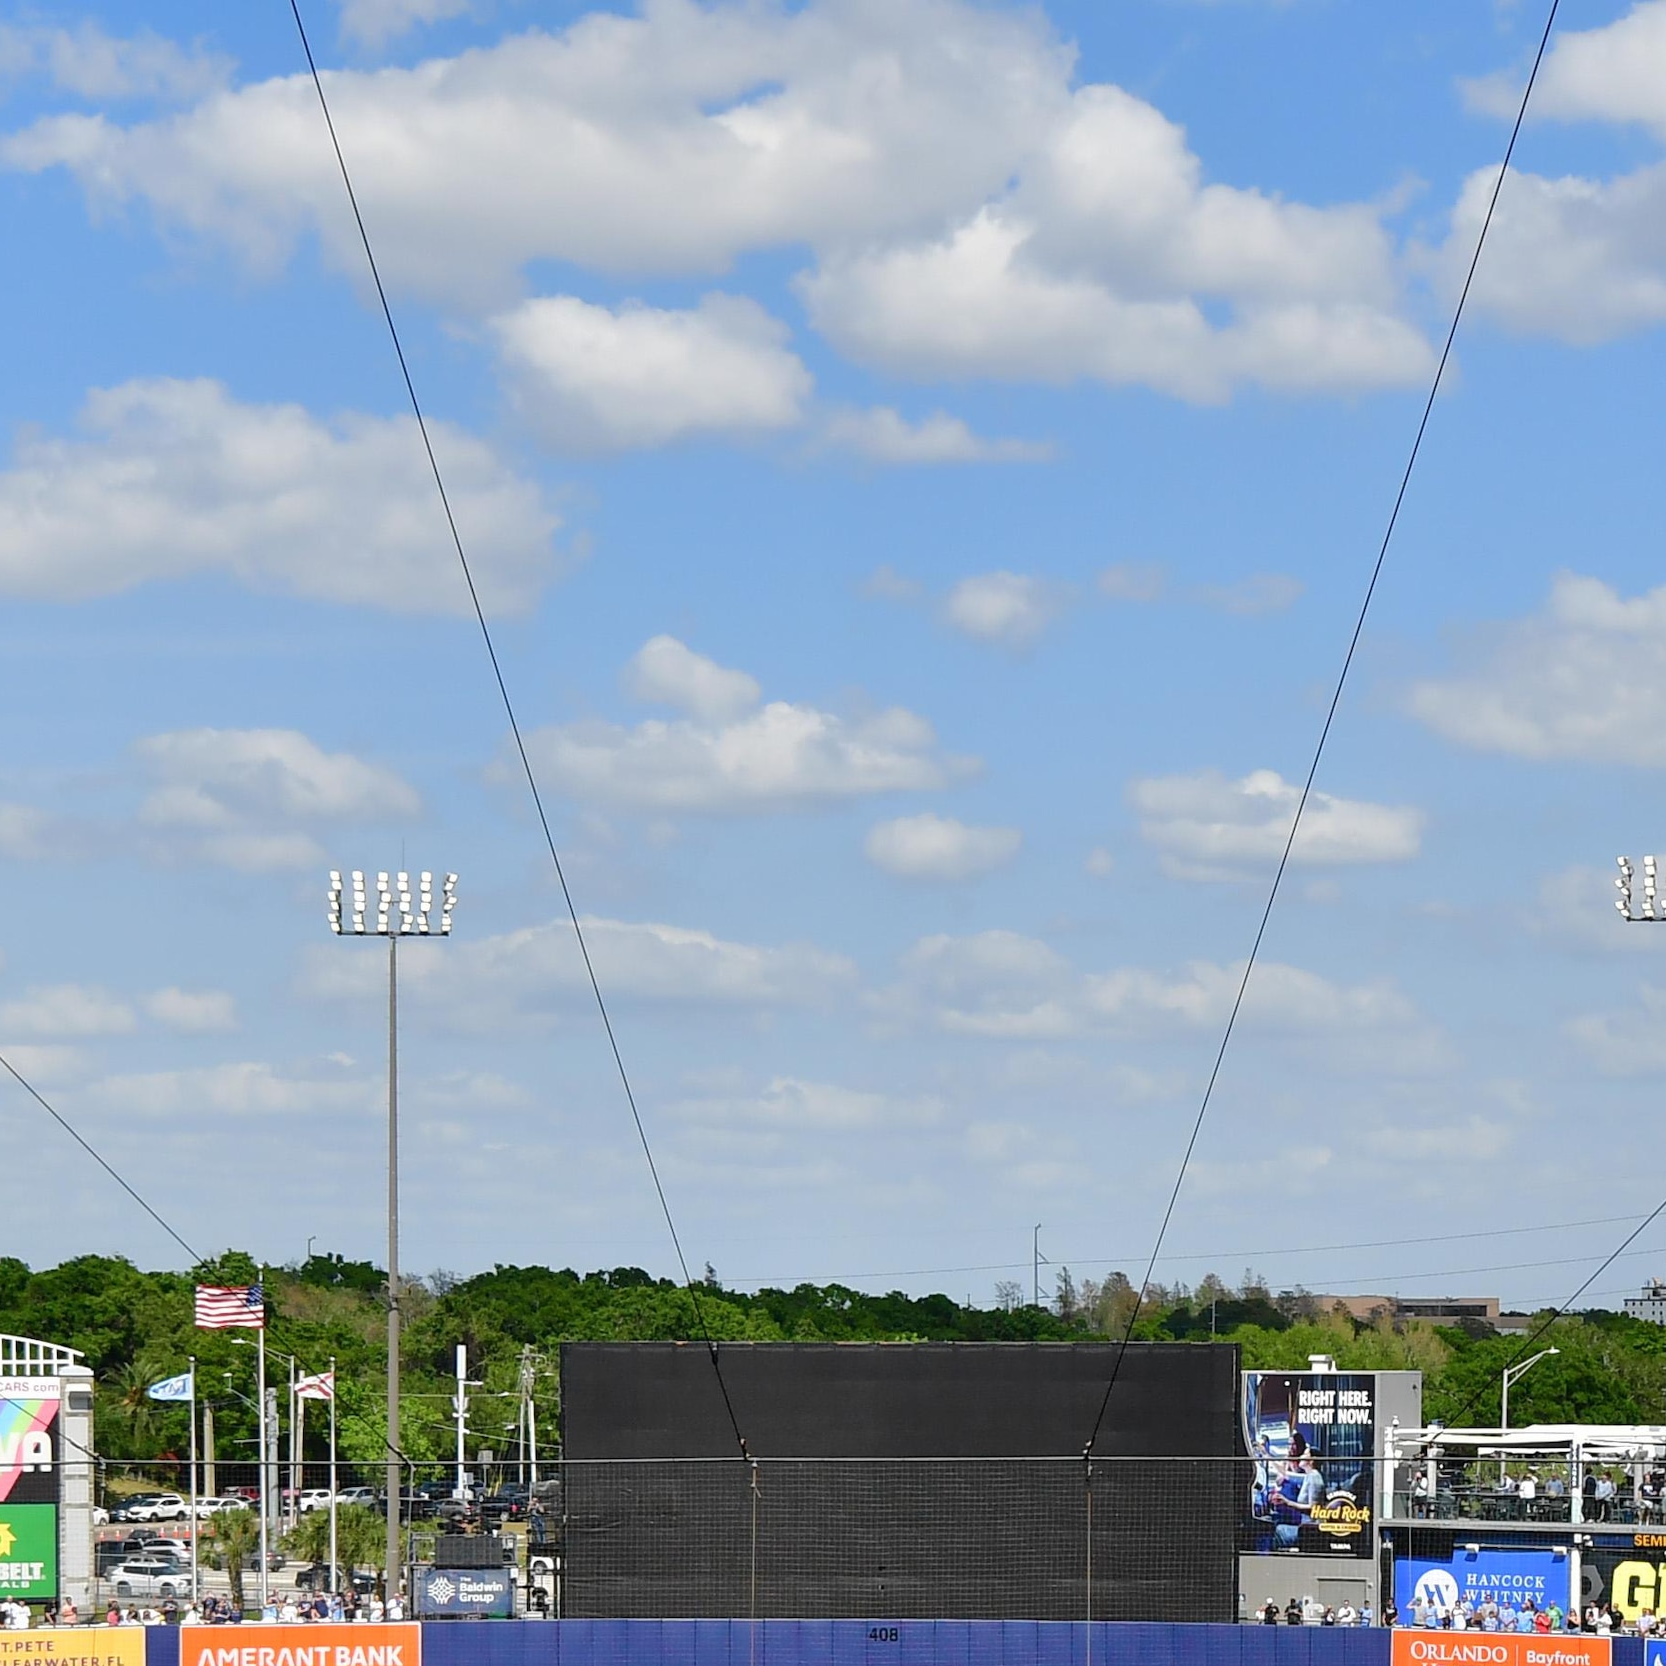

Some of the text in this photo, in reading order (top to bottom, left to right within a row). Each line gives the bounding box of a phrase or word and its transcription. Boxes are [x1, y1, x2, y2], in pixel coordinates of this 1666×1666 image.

[1299, 1390, 1372, 1407] RIGHT HERE.
[1298, 1408, 1372, 1425] RIGHT NOW.
[1310, 1505, 1371, 1523] Hard Rock
[459, 1581, 503, 1592] Baldwin
[1466, 1571, 1548, 1589] HANCOCK
[459, 1593, 494, 1603] Group
[868, 1626, 899, 1642] 408
[1409, 1640, 1508, 1664] ORLANDO
